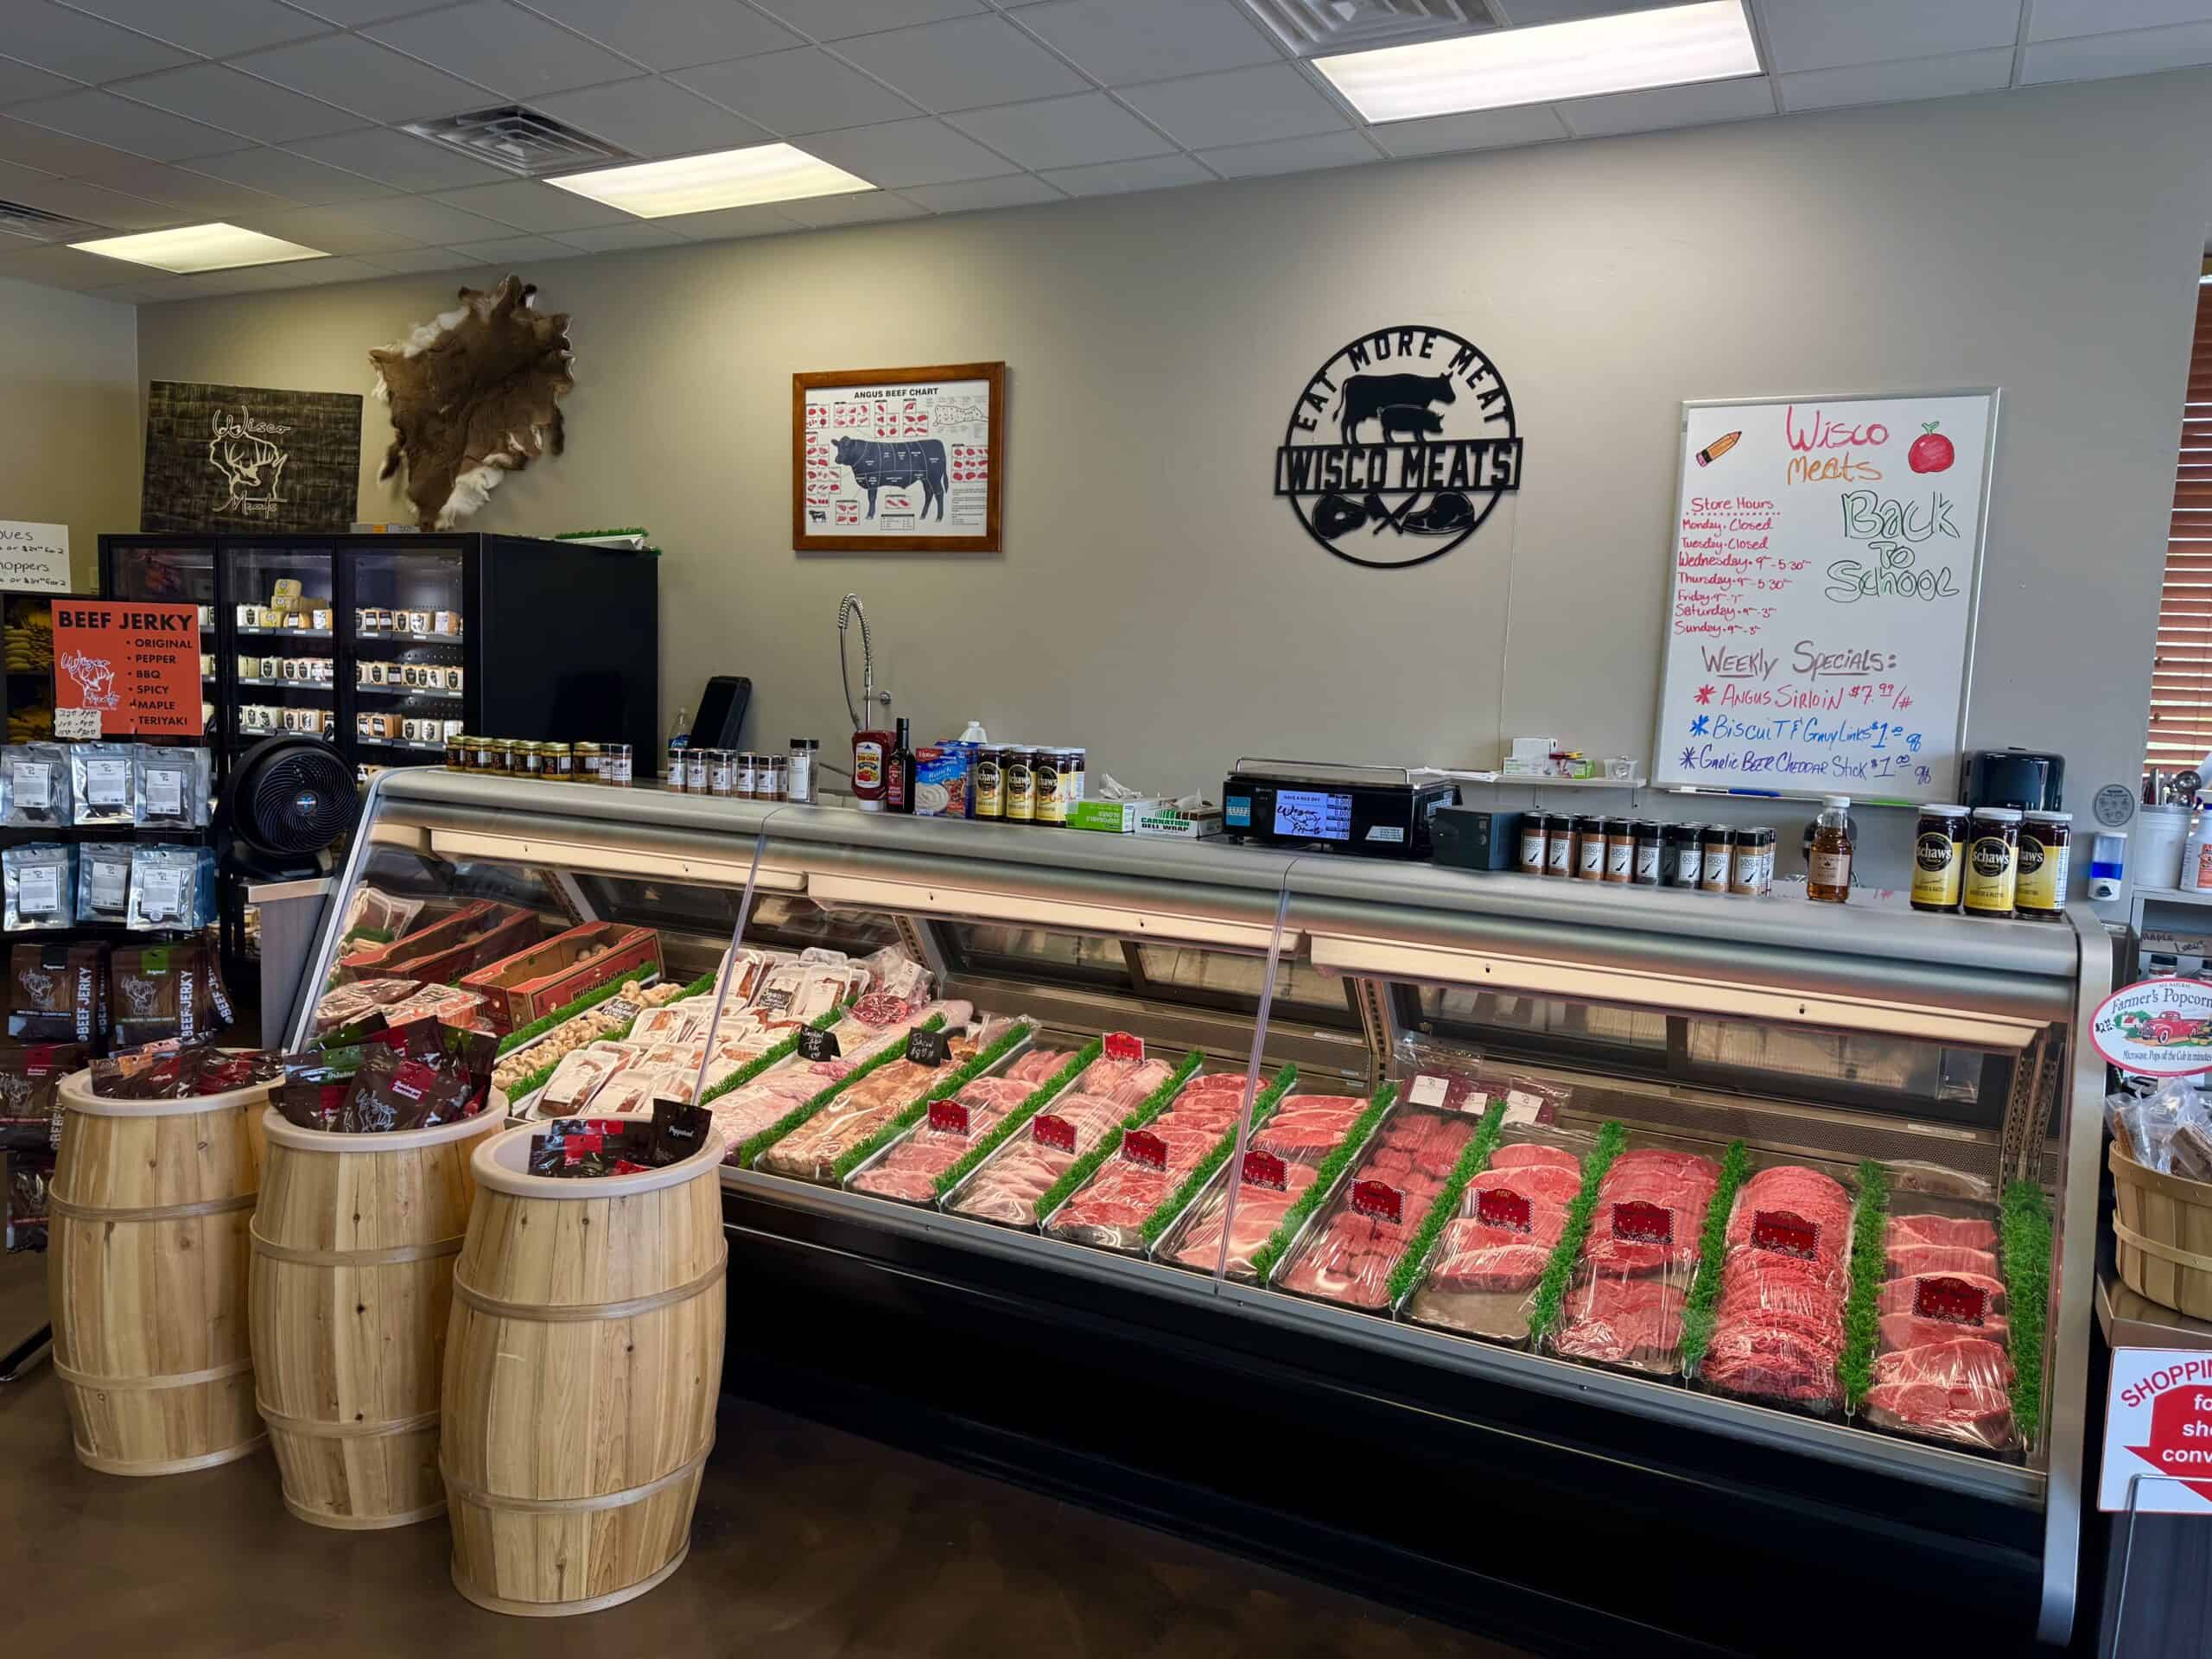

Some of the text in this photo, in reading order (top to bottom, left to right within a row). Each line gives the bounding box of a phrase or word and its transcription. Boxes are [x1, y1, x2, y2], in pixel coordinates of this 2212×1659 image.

[1296, 331, 1509, 432] EAT MORE MEAT
[854, 387, 939, 399] ANGUS BEEF CHART
[1785, 404, 1890, 453] Wisco
[1289, 442, 1511, 491] WISCO MEATS
[1692, 497, 1774, 512] Store Hours
[59, 610, 194, 631] BEEF JERKY
[135, 638, 194, 649] ORIGINAL
[135, 654, 177, 664] PEPPER
[137, 671, 161, 680] BBQ
[137, 685, 169, 695] SPICY
[137, 701, 175, 710] MAPLE
[138, 715, 188, 726] TERIYAKI
[1972, 847, 2010, 865] schaws
[76, 967, 92, 1034] BEEF JERKY
[180, 969, 194, 1037] BEEF JERKY
[2112, 988, 2212, 1014] Farmer's Popcorn
